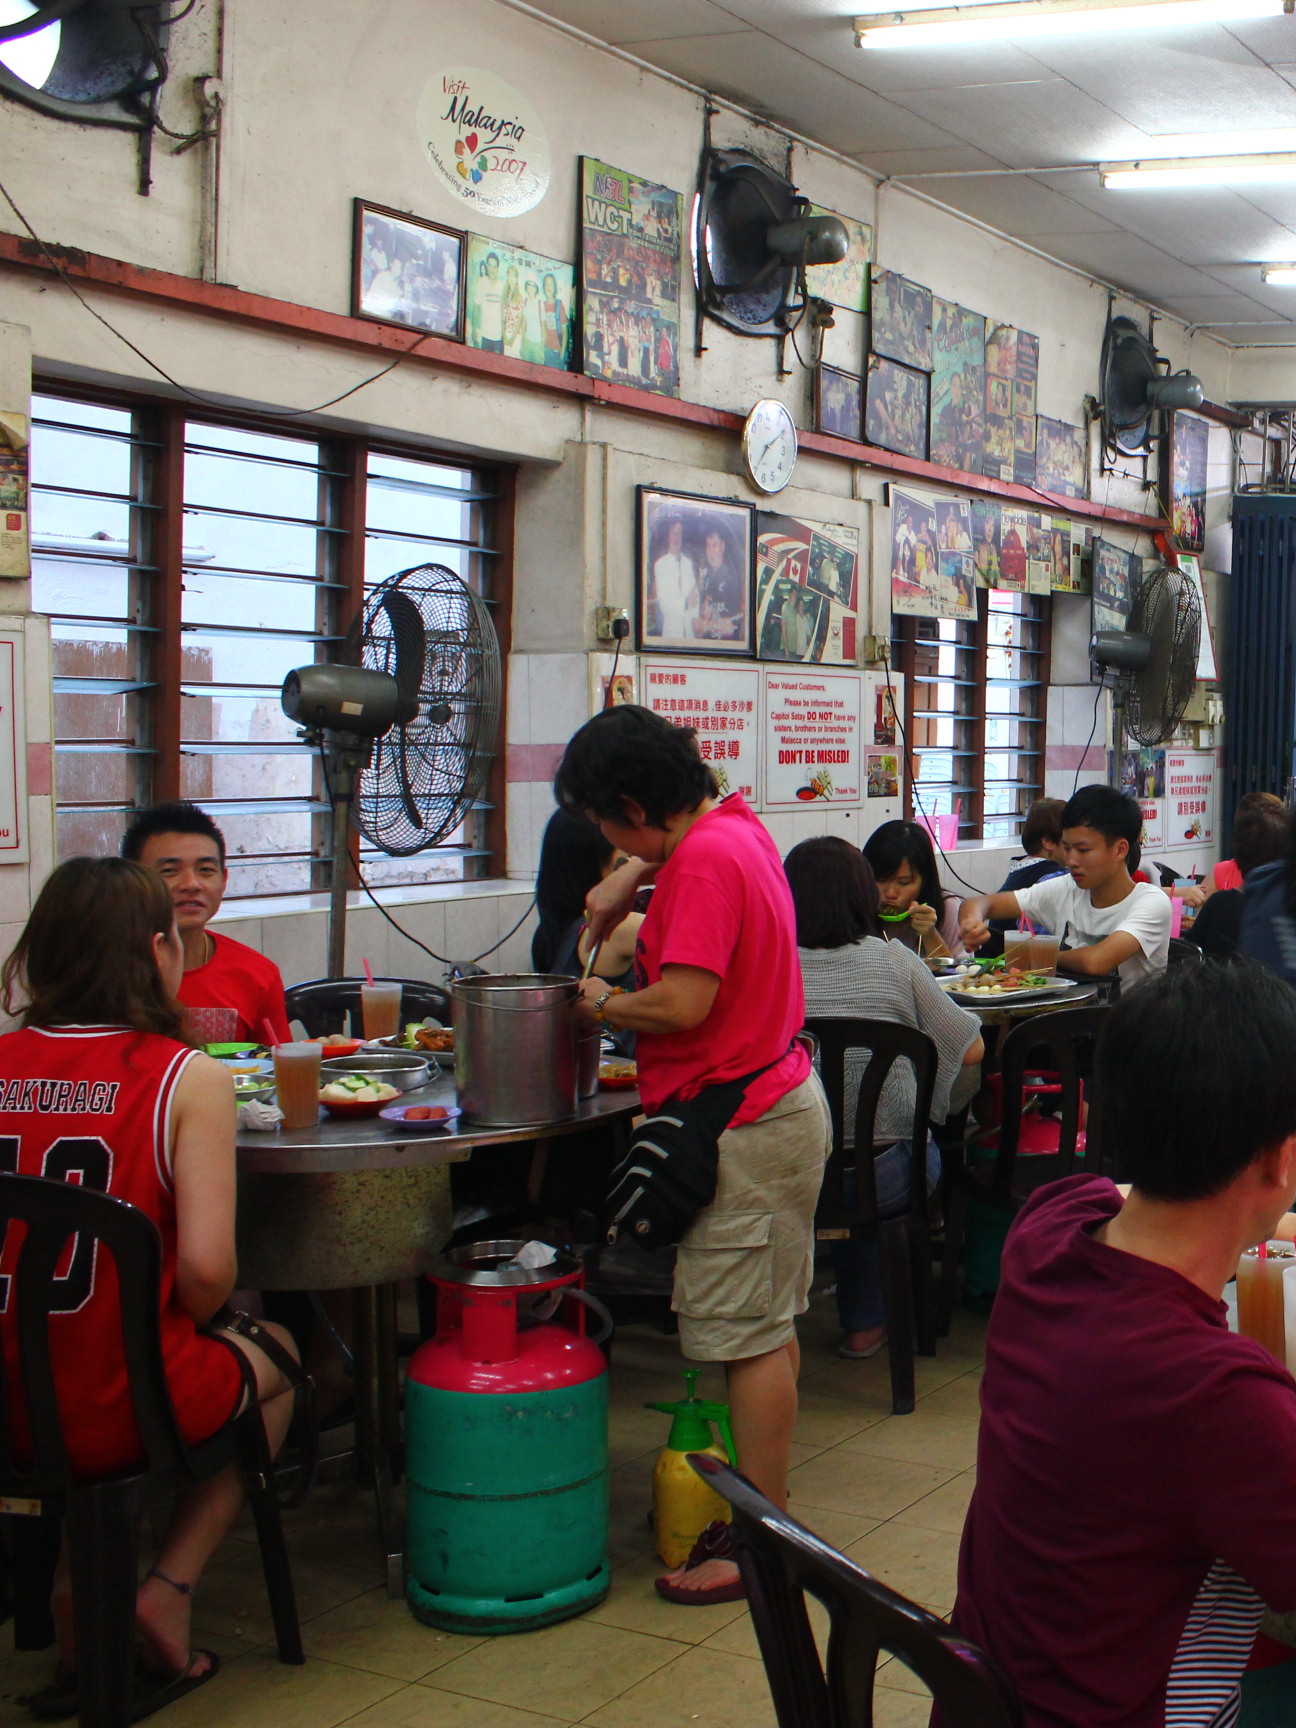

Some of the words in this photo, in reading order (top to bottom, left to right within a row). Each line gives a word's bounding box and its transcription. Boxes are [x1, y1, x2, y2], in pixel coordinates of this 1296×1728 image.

[443, 76, 471, 96] Visit
[440, 96, 525, 144] Malaysia
[428, 141, 463, 192] Celebrating
[462, 187, 476, 198] 50
[490, 155, 527, 183] 2007
[586, 195, 632, 237] WCT
[650, 673, 686, 685] 親愛的顧客
[768, 681, 779, 689] Dear
[781, 682, 797, 690] Valued
[799, 683, 826, 692] Customers,
[784, 698, 801, 707] Please
[803, 699, 809, 707] be
[811, 699, 832, 707] informed
[834, 700, 844, 708] that
[771, 712, 790, 721] Capitol
[791, 712, 806, 722] Satay
[807, 712, 816, 720] DO
[819, 712, 833, 721] NOT
[847, 715, 856, 723] any
[774, 725, 793, 733] sisters,
[795, 725, 816, 733] brothers
[824, 725, 847, 733] branches
[848, 725, 853, 733] in
[781, 736, 802, 744] Malacca
[810, 736, 834, 746] anywhere
[701, 741, 740, 760] 受誤導
[779, 750, 803, 764] DON'T
[805, 750, 815, 763] BE
[817, 750, 849, 763] MISLED!
